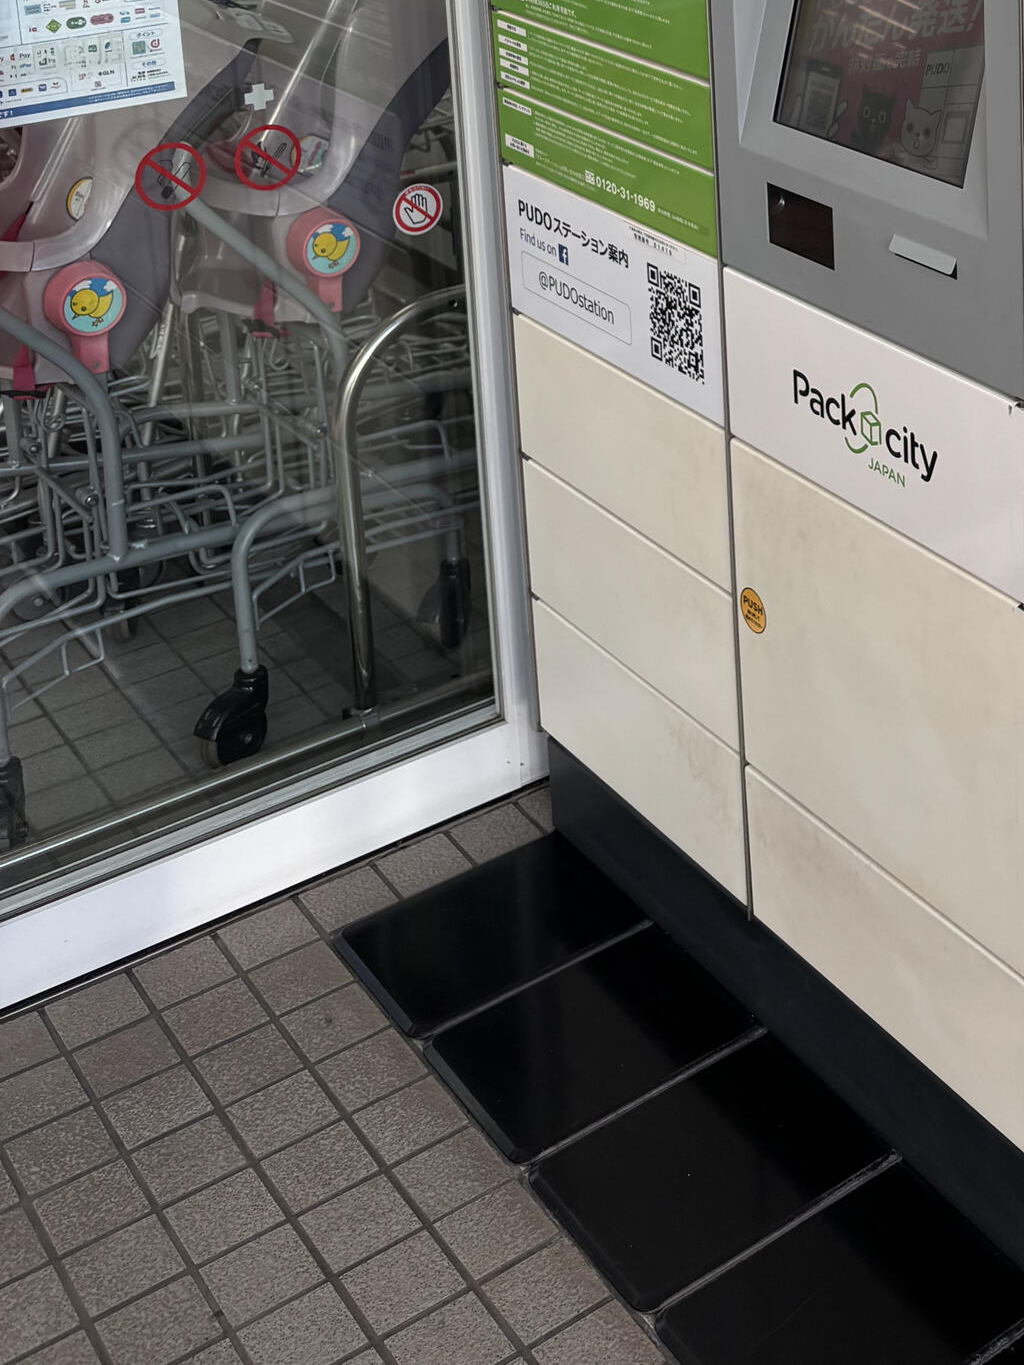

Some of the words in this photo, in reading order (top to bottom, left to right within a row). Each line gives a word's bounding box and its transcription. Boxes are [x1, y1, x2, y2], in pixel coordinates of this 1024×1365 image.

[518, 199, 629, 268] PUDOステーション案内
[519, 227, 536, 247] Find
[537, 238, 546, 252] us
[546, 242, 557, 257] on
[538, 271, 614, 324] @PUDOstation
[793, 369, 857, 435] Pack
[885, 426, 938, 482] city
[867, 457, 906, 487] JAPAN
